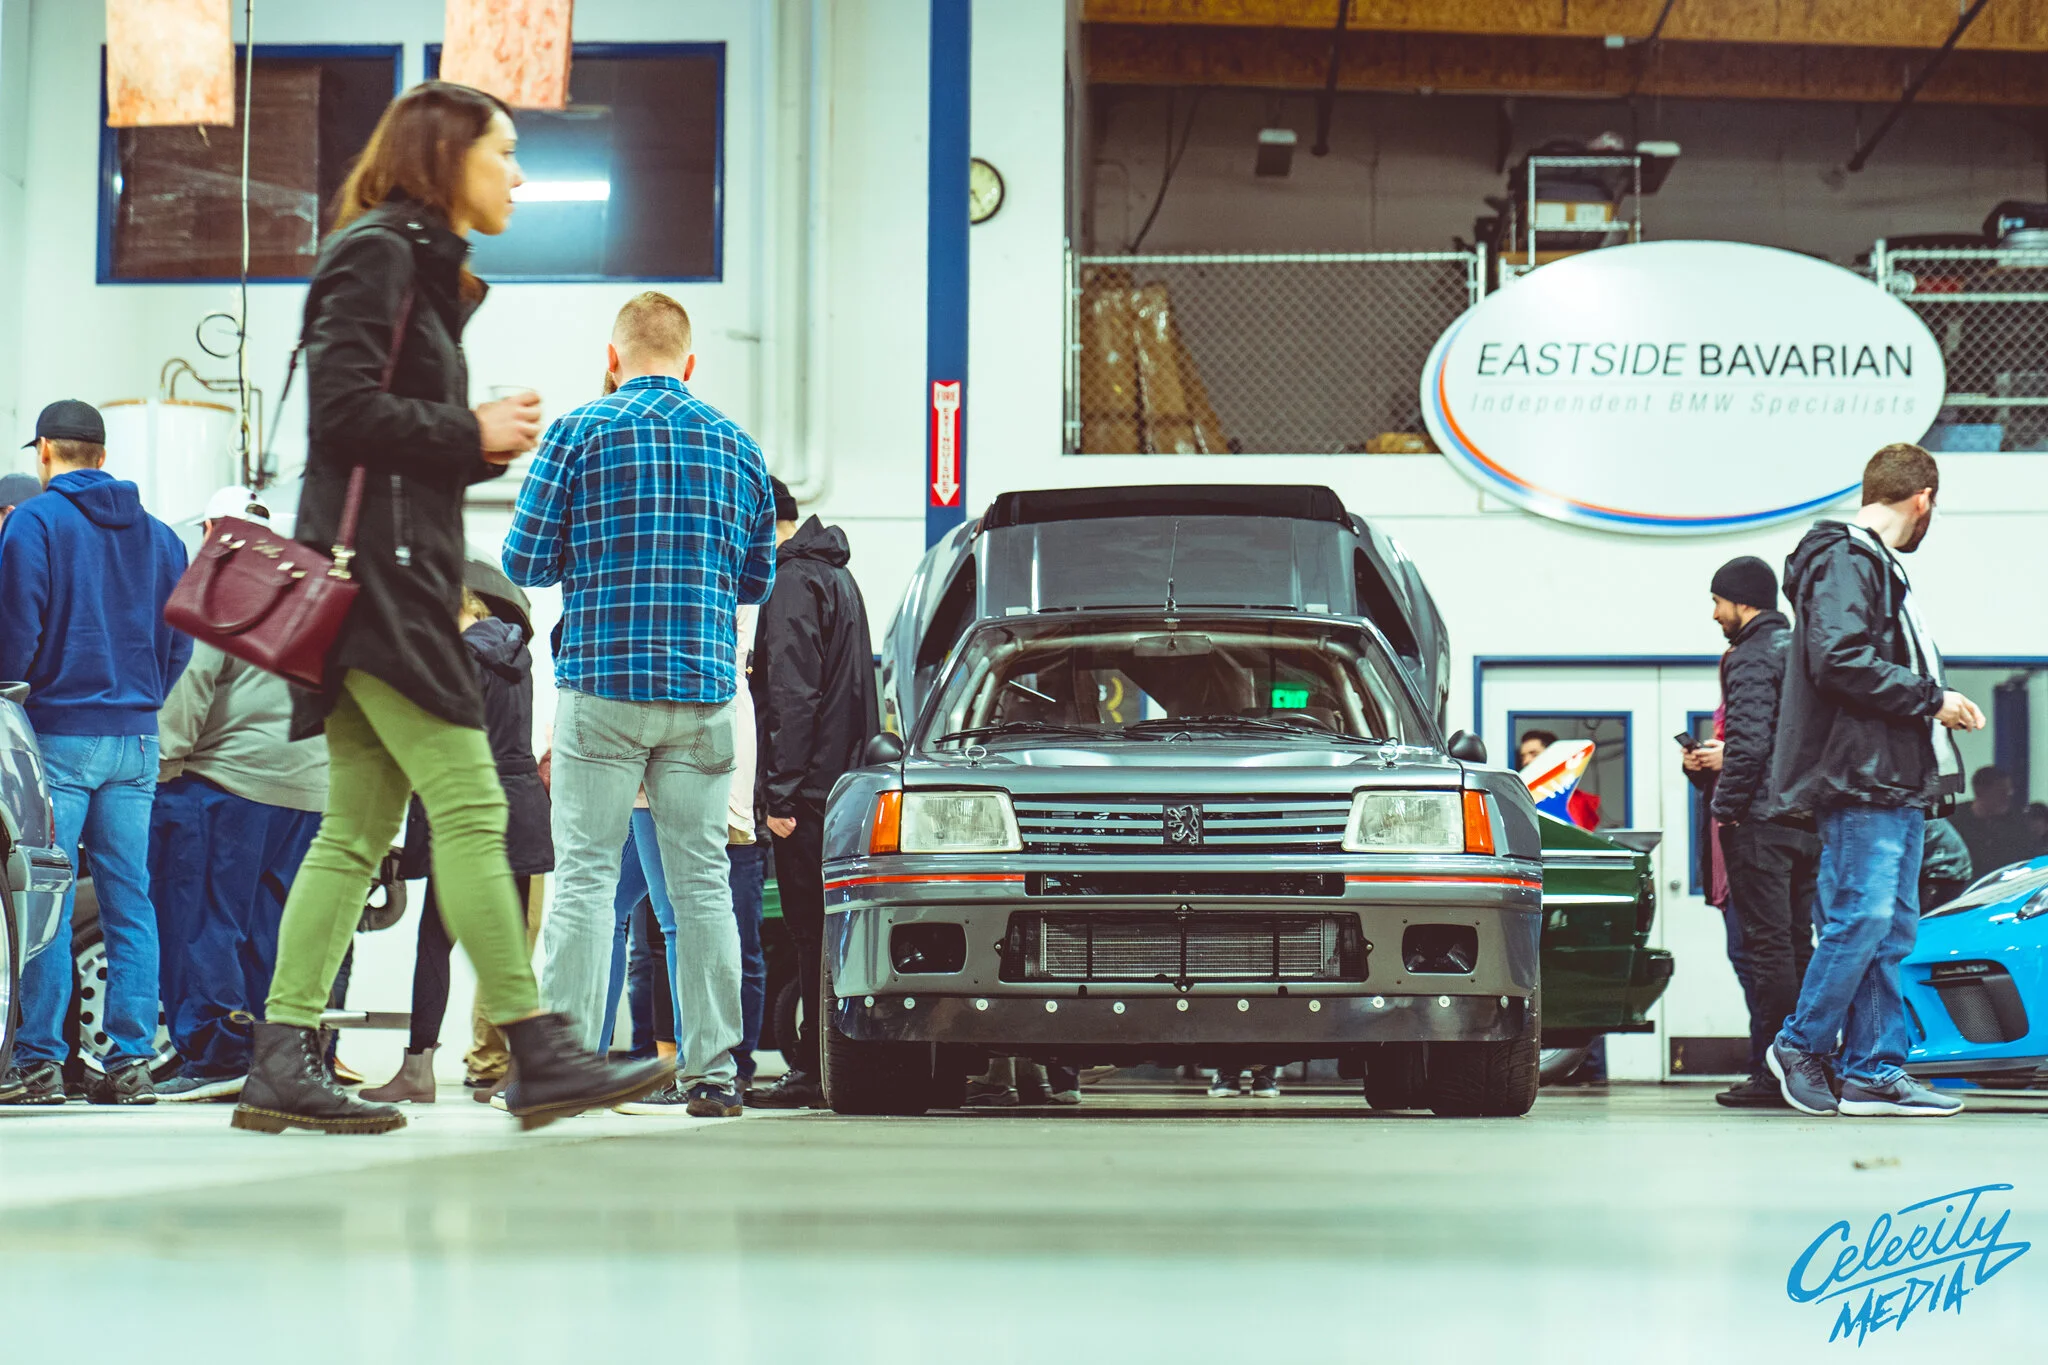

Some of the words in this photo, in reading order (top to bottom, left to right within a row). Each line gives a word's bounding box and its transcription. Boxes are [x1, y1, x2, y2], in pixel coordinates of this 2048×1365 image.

[1477, 342, 1688, 376] EASTSIDE
[1699, 343, 1912, 378] BAVARIAN
[1471, 391, 1652, 416] Independent
[1668, 391, 1734, 414] BMW
[1750, 392, 1915, 417] Specialists
